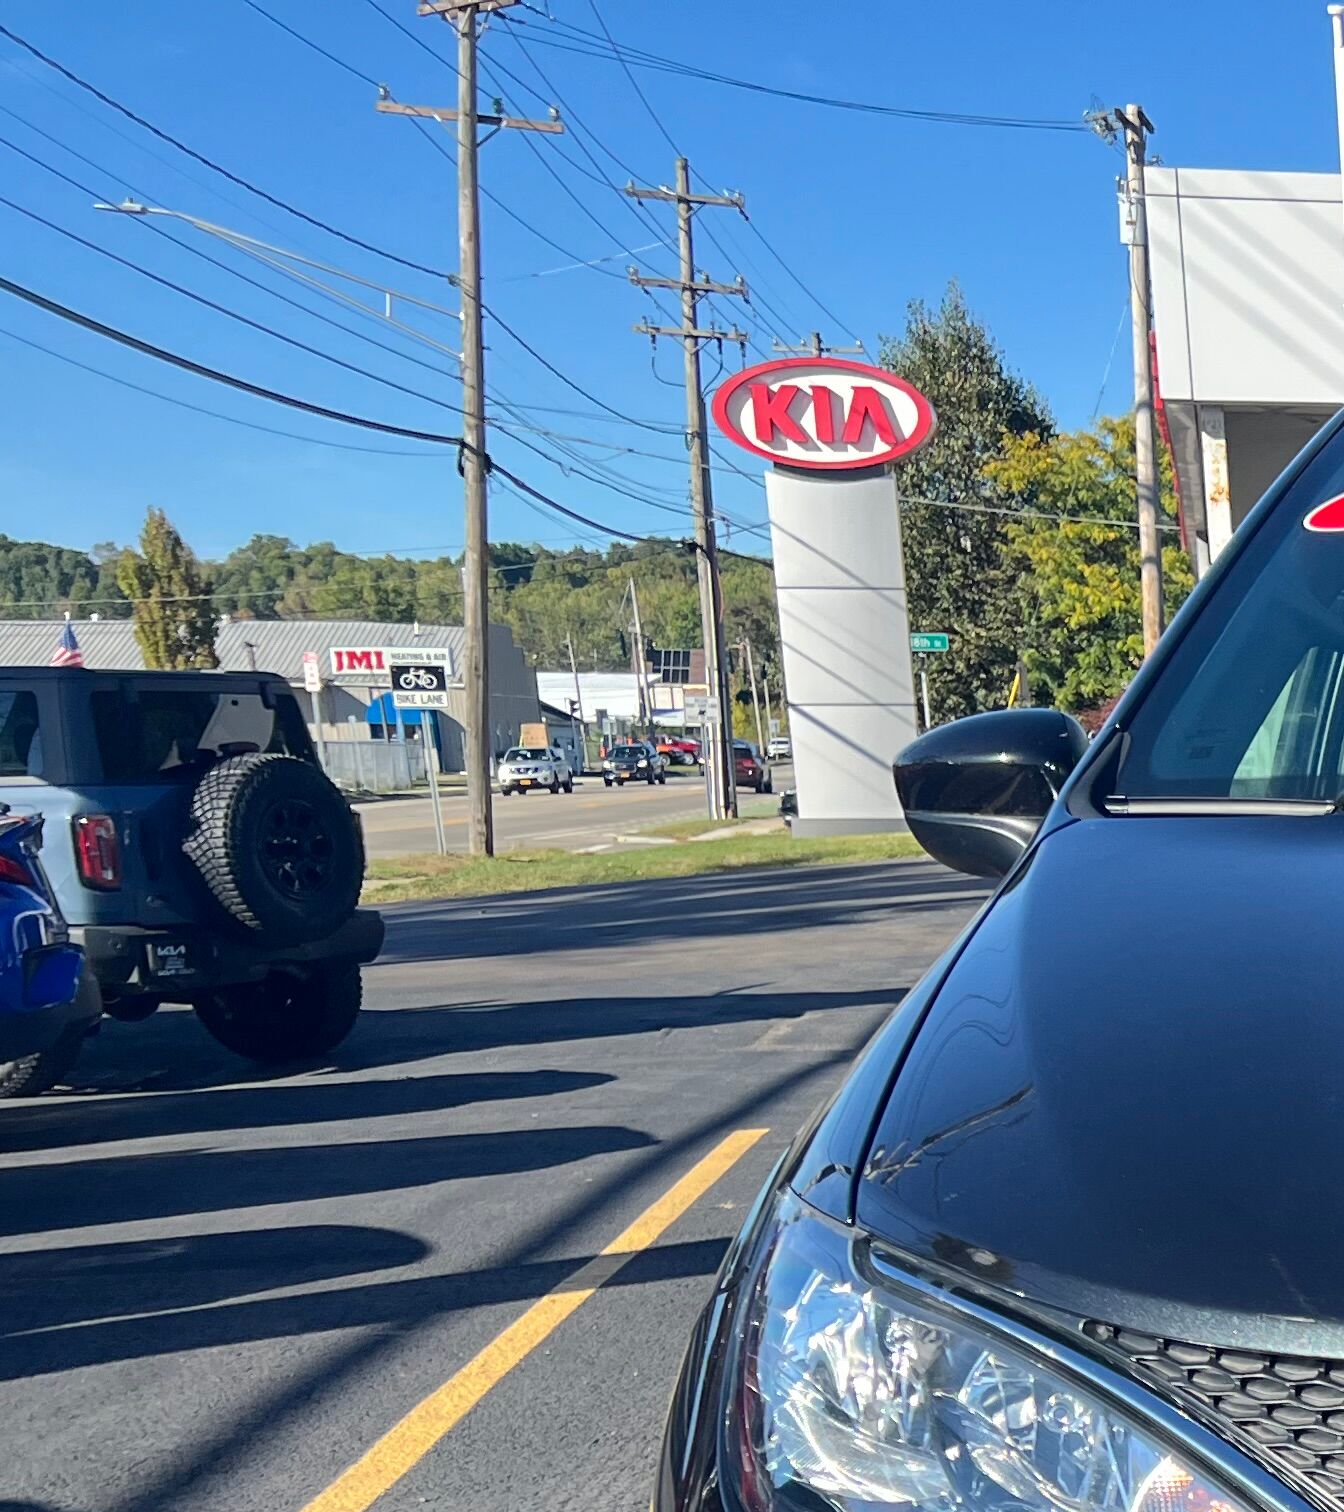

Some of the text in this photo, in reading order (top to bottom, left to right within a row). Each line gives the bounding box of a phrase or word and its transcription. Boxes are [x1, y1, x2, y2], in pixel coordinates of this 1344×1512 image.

[747, 383, 898, 446] KIA
[334, 650, 385, 672] JMI
[396, 693, 445, 705] BIKE LANE
